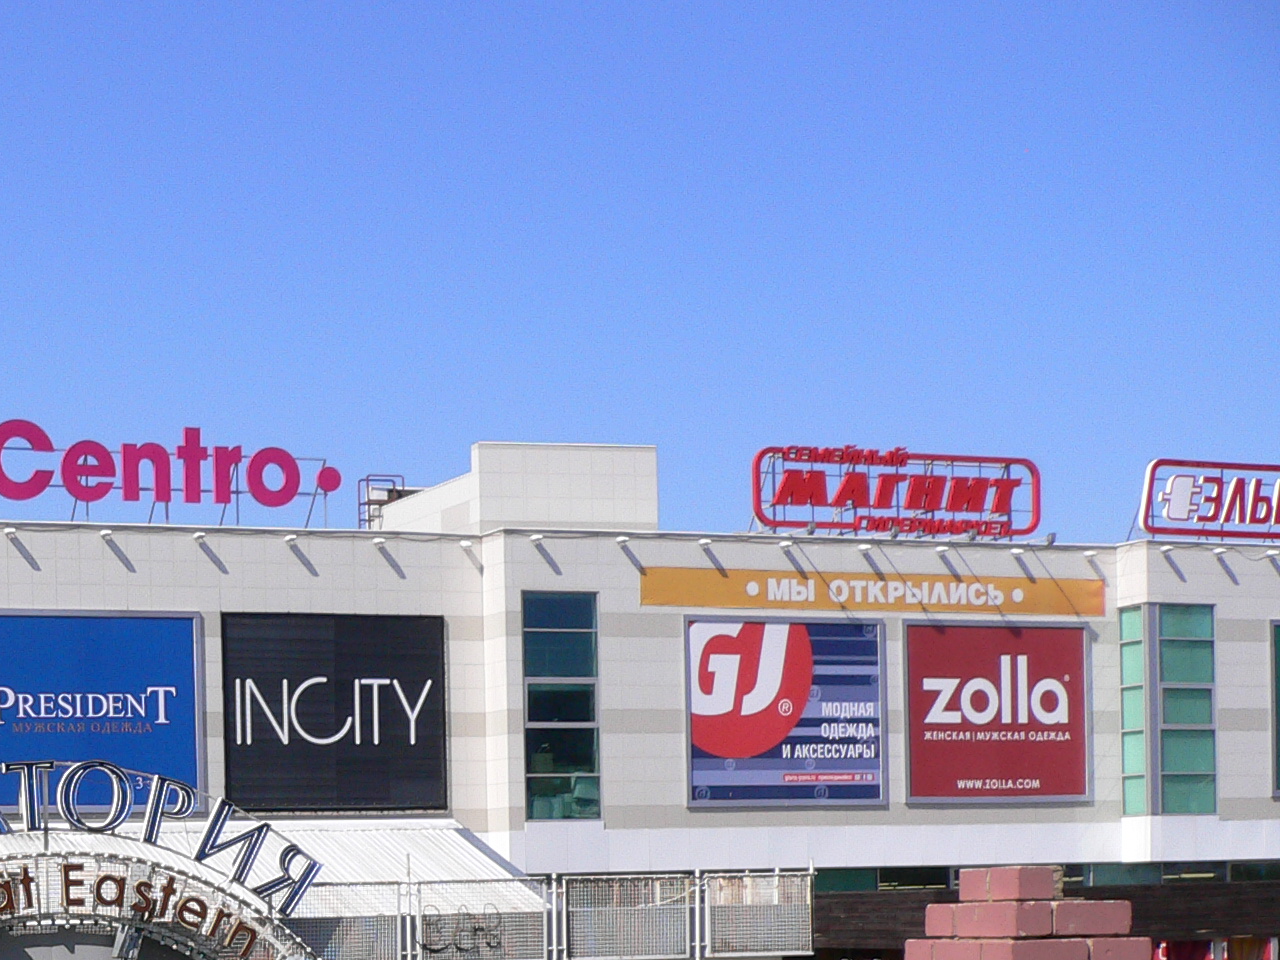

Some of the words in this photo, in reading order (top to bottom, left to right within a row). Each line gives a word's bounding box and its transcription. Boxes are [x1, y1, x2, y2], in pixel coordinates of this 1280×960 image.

[772, 469, 1023, 514] МАГНИТ
[766, 577, 816, 603] МЫ
[828, 578, 1006, 608] ОТКРЫЛИСЬ
[922, 654, 1070, 726] zolla
[233, 675, 433, 747] INCITY
[821, 701, 875, 720] МОДНАЯ
[11, 720, 86, 734] МУЖСКАЯ
[90, 721, 153, 734] ОДЕЖДА
[820, 722, 876, 741] ОДЕЖДА
[1027, 730, 1072, 742] ОДЕЖДА
[781, 743, 792, 759] И
[793, 743, 876, 759] АКСЕССУАРЫ
[956, 778, 1041, 790] WWW.ZOLLA.COM
[60, 862, 261, 960] Eastern
